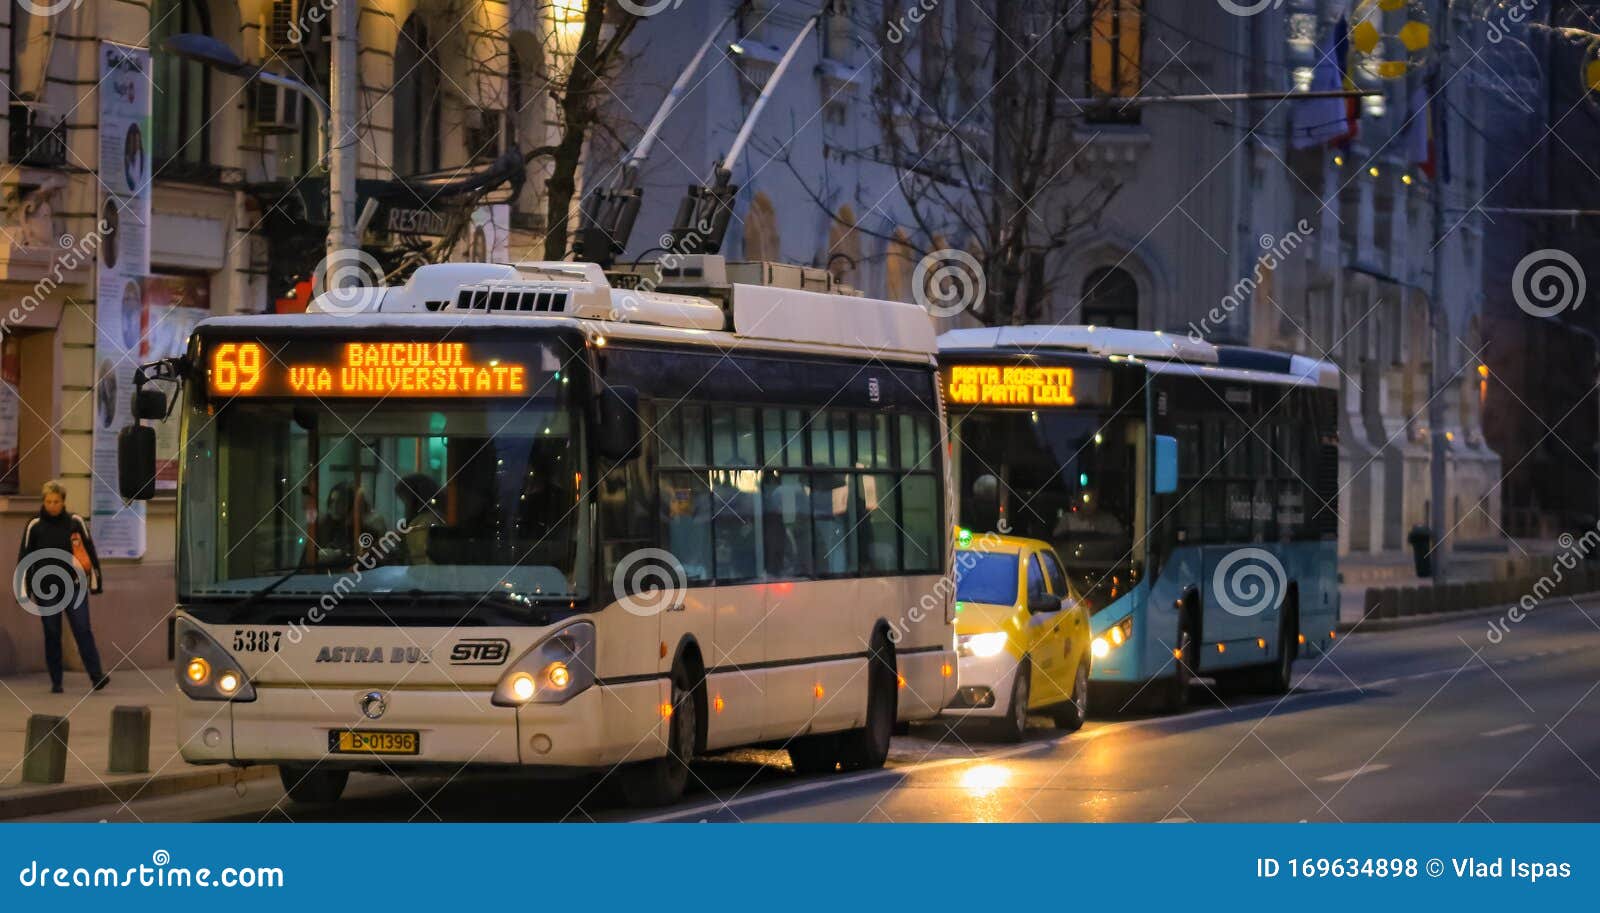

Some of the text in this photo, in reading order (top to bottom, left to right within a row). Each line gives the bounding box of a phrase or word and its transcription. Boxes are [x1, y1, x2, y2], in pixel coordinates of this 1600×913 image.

[349, 343, 464, 366] BAICULUI
[215, 343, 260, 391] 69
[952, 367, 1072, 385] PIATA ROSETTI
[290, 367, 524, 390] VIA UNIVERSITATE
[950, 384, 977, 401] VIA
[982, 384, 1028, 402] PIATA
[233, 630, 281, 652] 5387
[315, 646, 384, 663] ASTRA
[450, 642, 506, 662] STB
[369, 734, 413, 750] 01396
